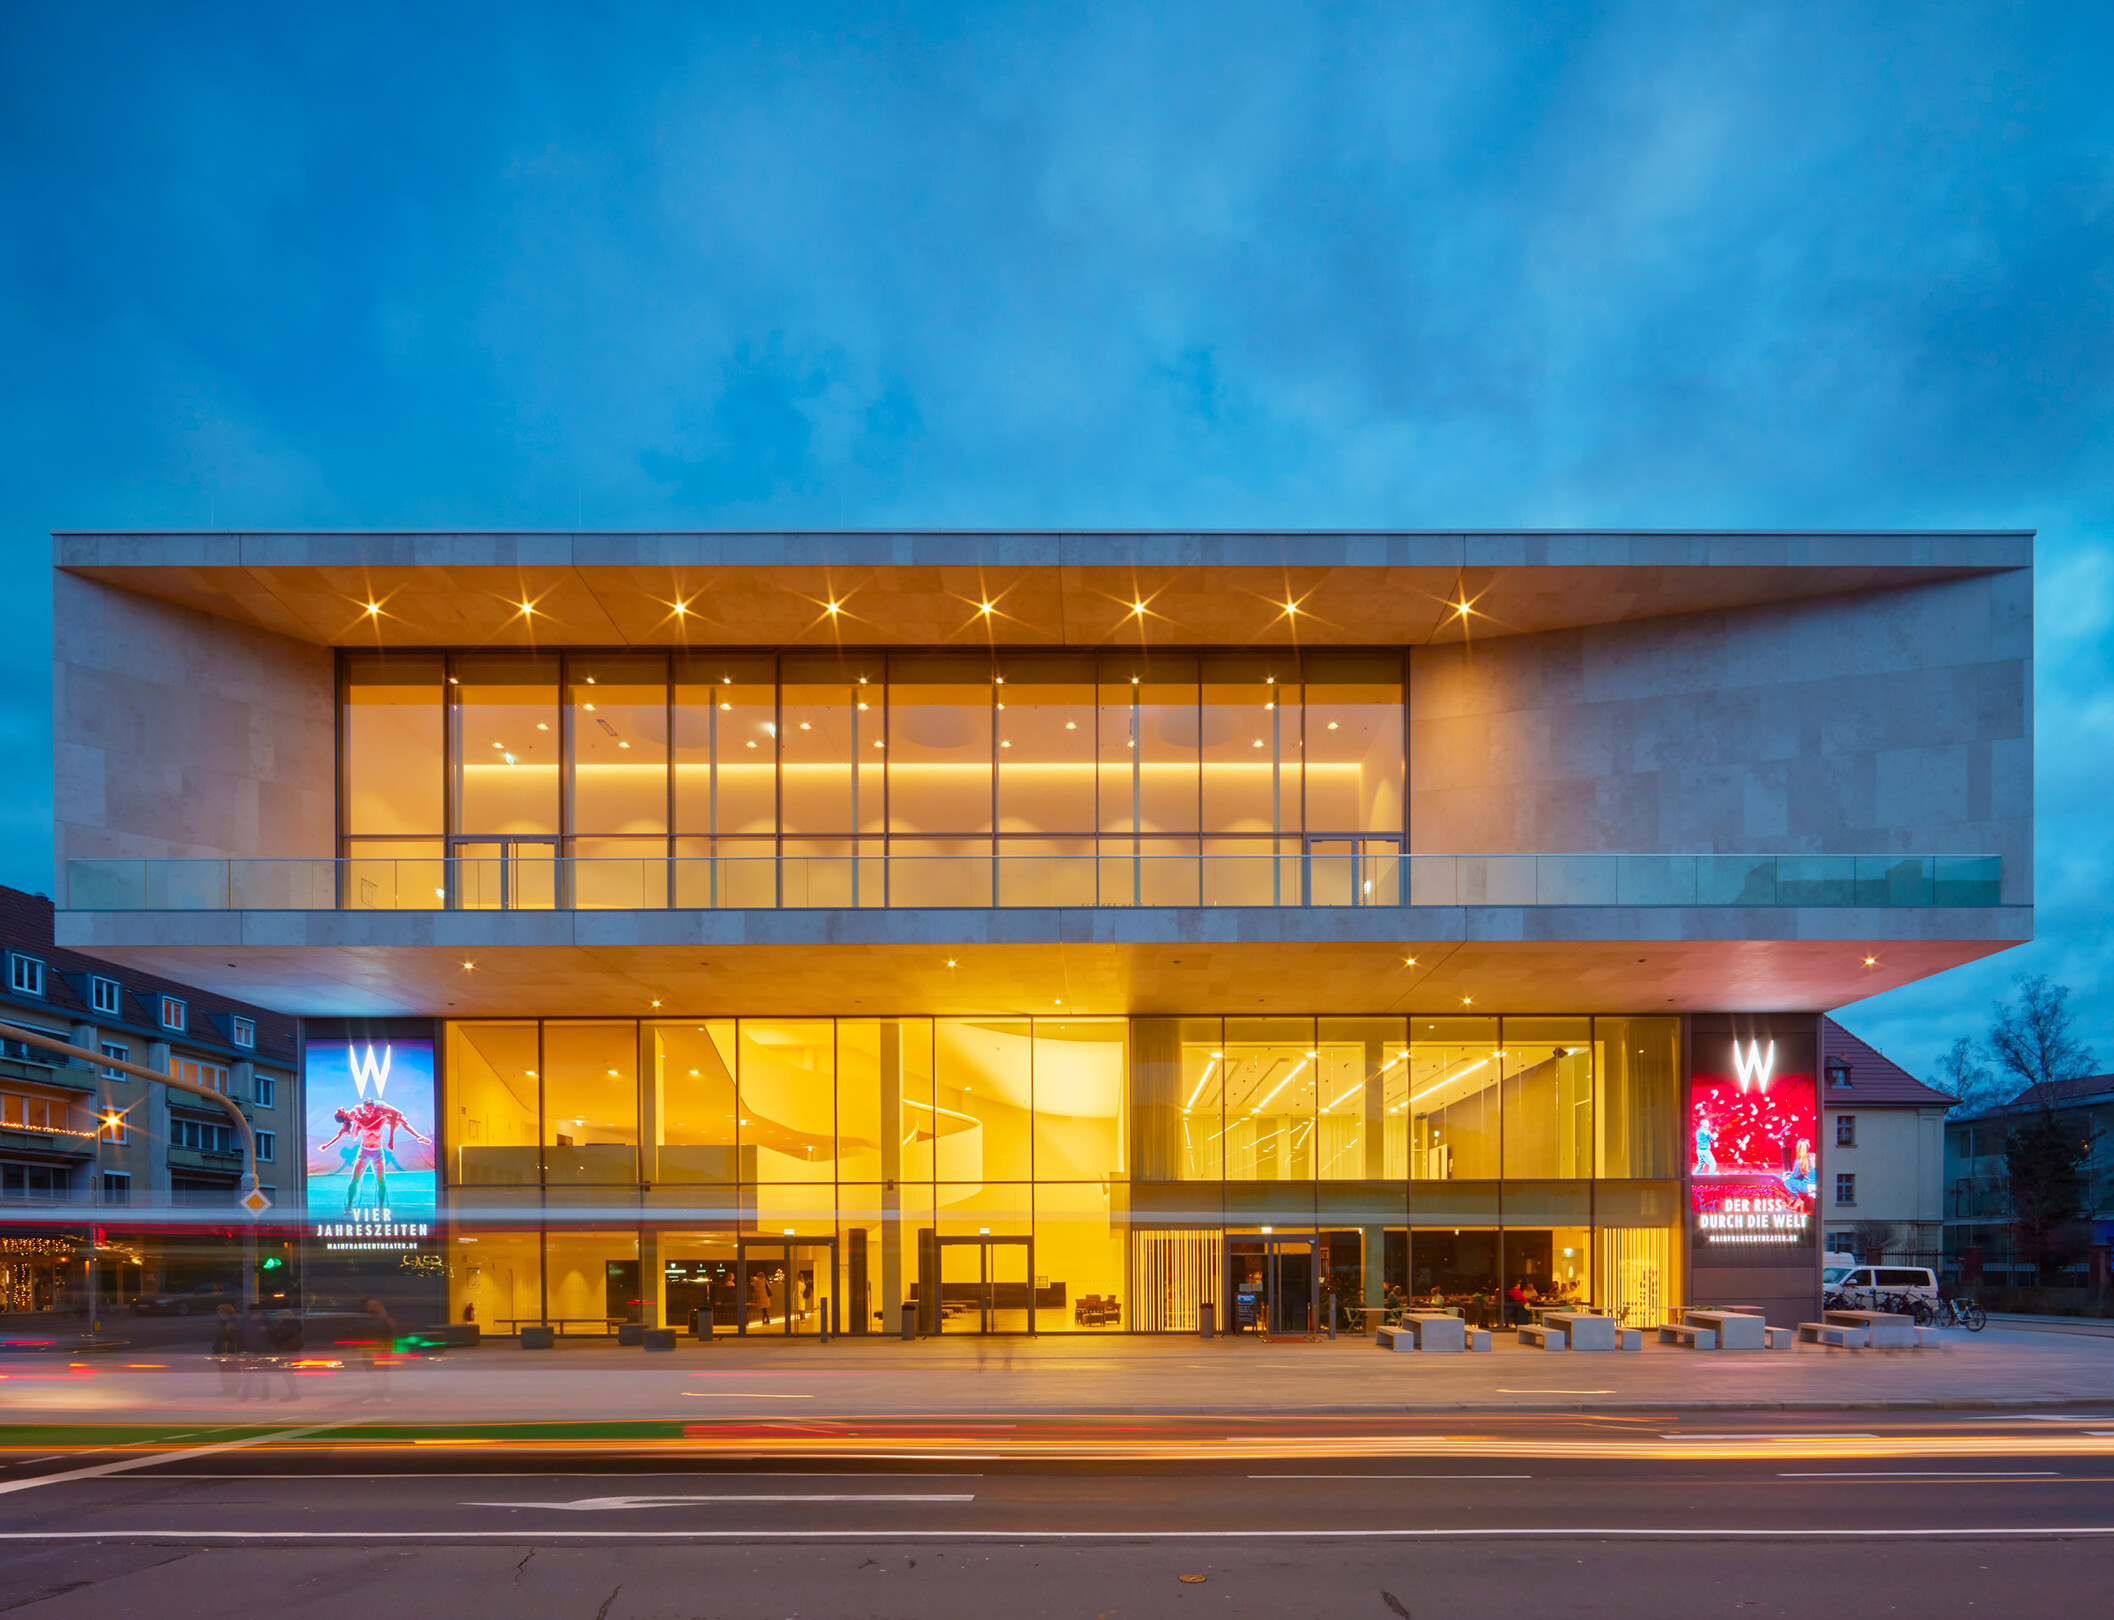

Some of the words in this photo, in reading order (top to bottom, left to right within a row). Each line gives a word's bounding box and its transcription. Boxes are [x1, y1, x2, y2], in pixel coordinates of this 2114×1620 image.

[349, 1044, 391, 1099] W
[1734, 1040, 1775, 1094] W
[1725, 1199, 1750, 1212] DER
[1754, 1199, 1783, 1212] RISS
[352, 1208, 392, 1221] VIER
[1700, 1215, 1744, 1228] DURCH
[1748, 1215, 1769, 1228] DIE
[1773, 1215, 1808, 1228] WELT
[316, 1224, 428, 1236] JAHRESZEITEN
